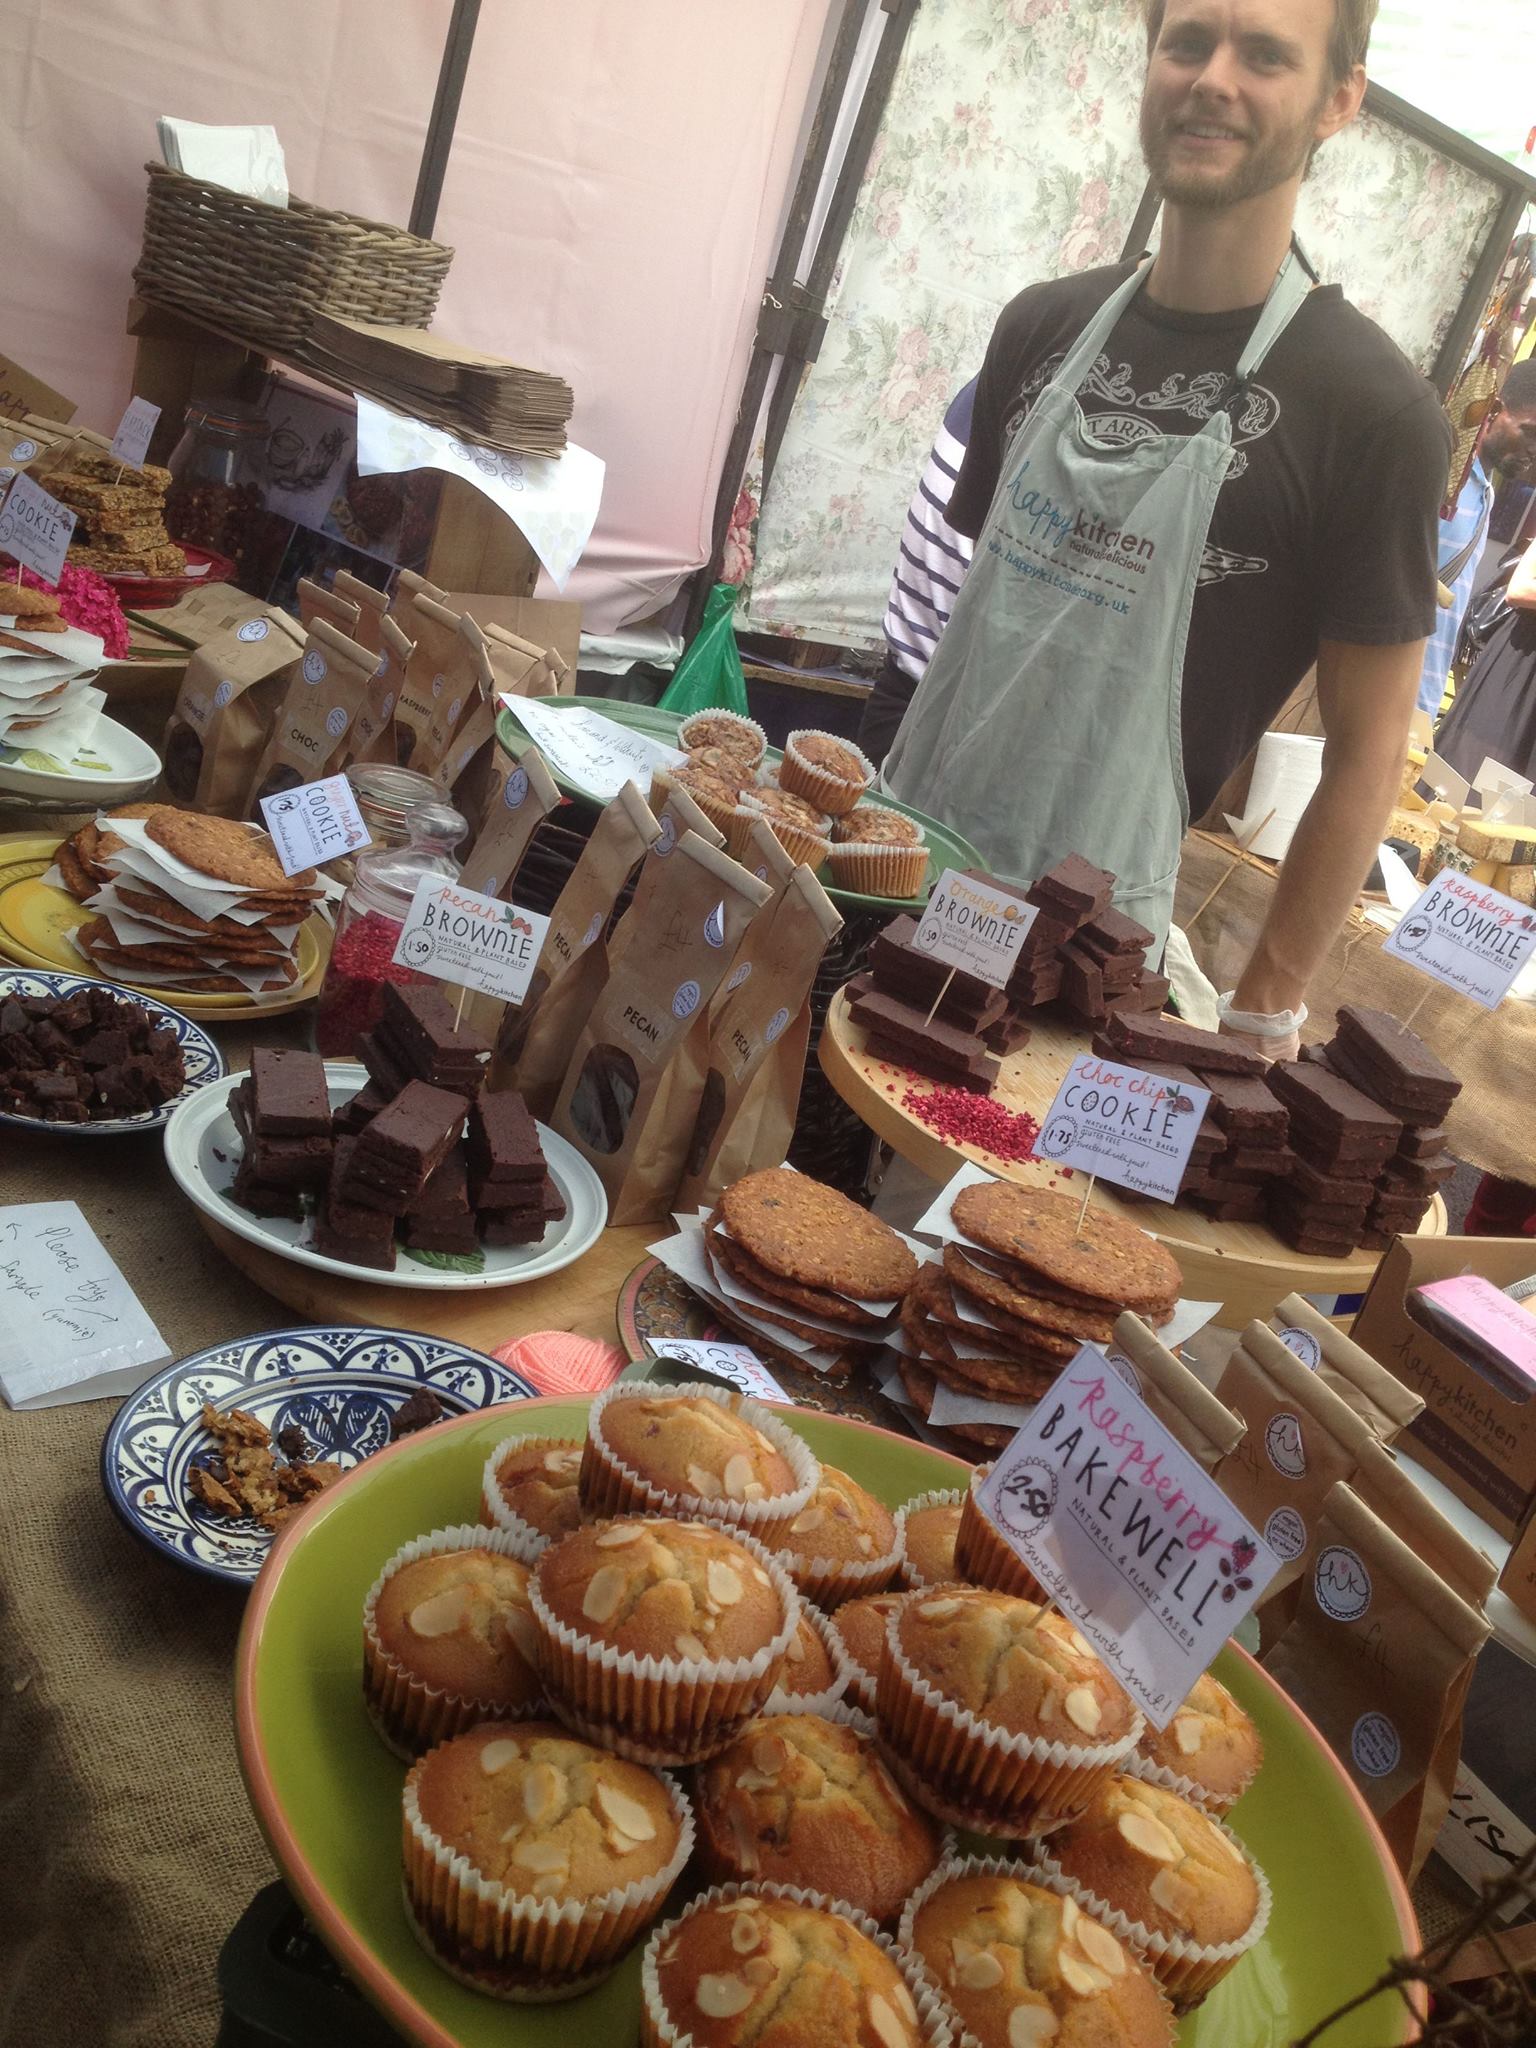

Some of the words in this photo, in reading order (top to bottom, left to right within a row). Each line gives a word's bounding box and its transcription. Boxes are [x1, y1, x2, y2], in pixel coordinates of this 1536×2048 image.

[10, 494, 59, 542] COOKIE
[291, 728, 319, 753] CHOC
[306, 787, 342, 845] COOKIE
[623, 1005, 659, 1042] PECAN
[732, 1029, 752, 1063] PECAN
[1064, 1085, 1178, 1139] COOKIE
[1085, 1118, 1116, 1133] NATURAL
[1129, 1132, 1155, 1145] PLANT
[1122, 1169, 1175, 1196] happykitchen
[1039, 1403, 1219, 1628] BAKEWELL
[1070, 1498, 1114, 1554] NATURAL
[1118, 1554, 1127, 1566] &
[1128, 1566, 1162, 1606] PLANT
[1161, 1605, 1196, 1649] BASED
[1320, 1560, 1369, 1597] hk
